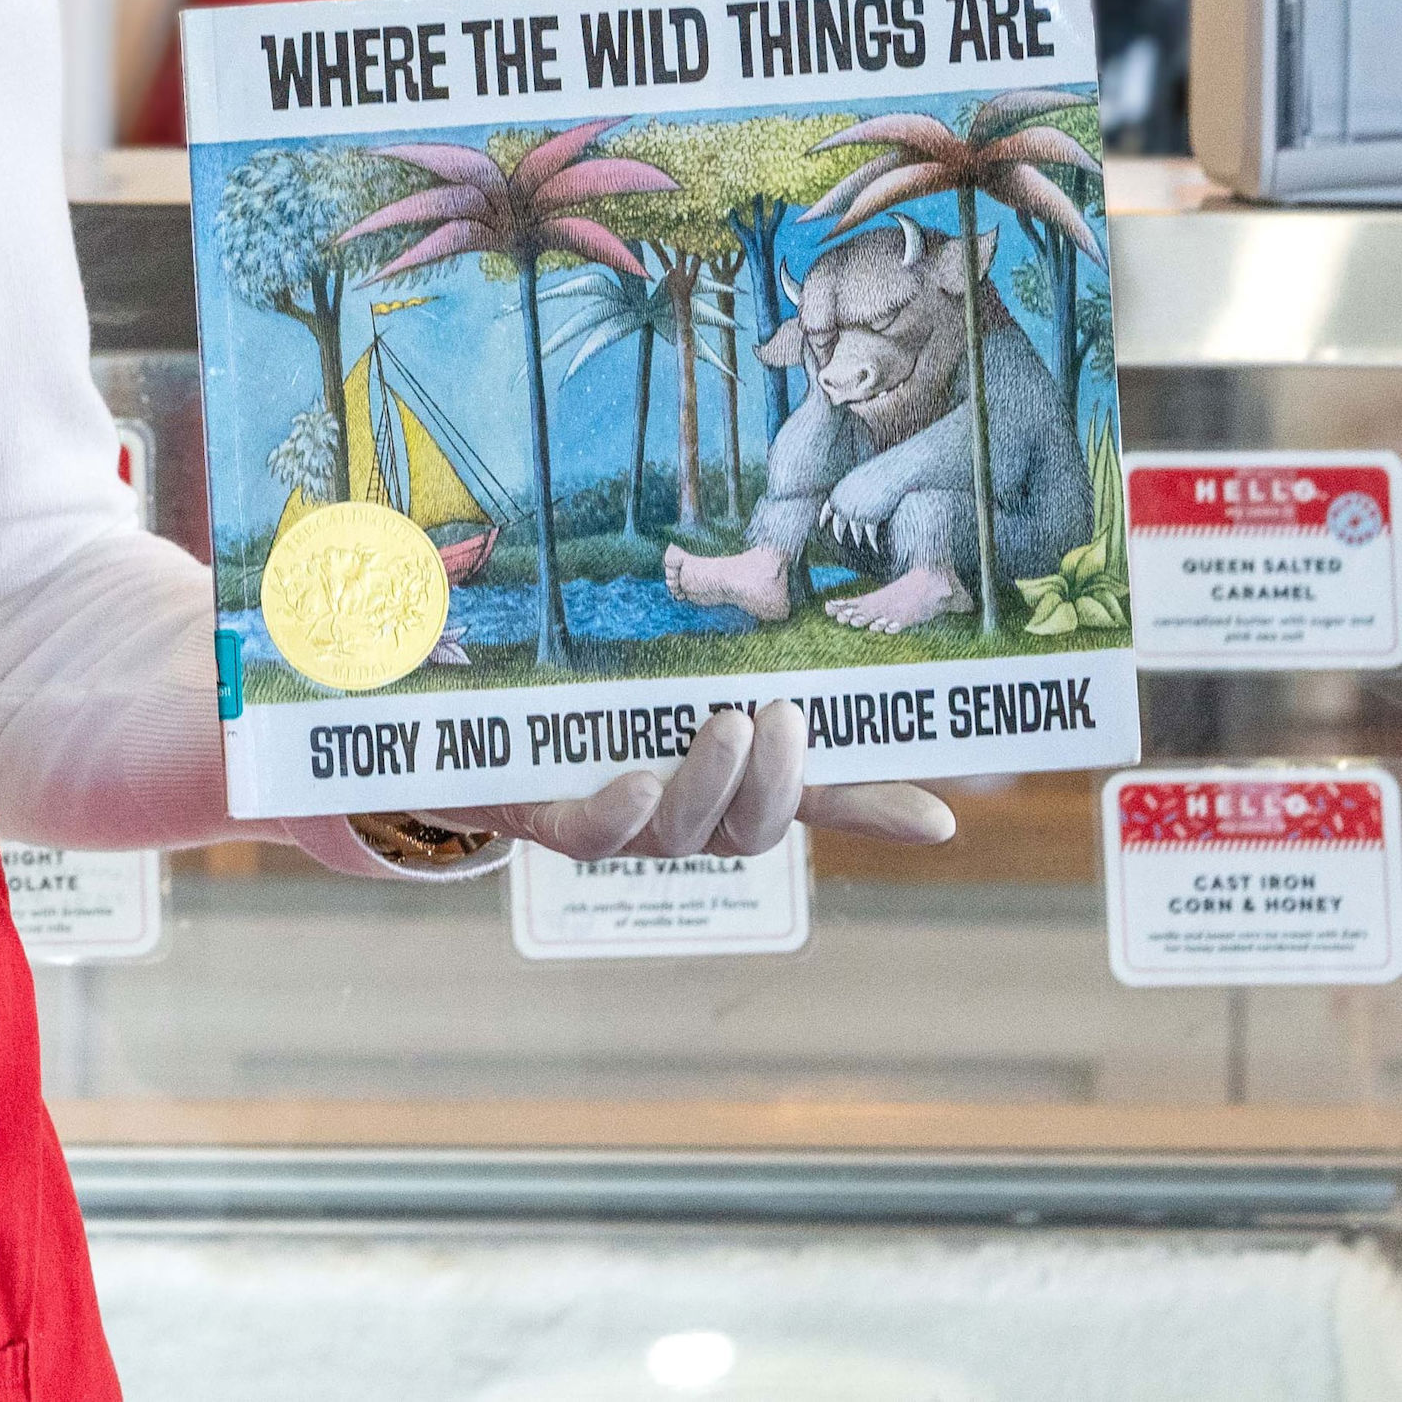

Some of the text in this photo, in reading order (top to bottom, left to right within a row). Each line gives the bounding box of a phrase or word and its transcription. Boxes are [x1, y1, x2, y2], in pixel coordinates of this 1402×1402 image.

[261, 22, 450, 112] WHERE
[462, 15, 562, 97] THE
[582, 6, 709, 88] WILD
[1196, 477, 1317, 504] HELLO
[1182, 556, 1343, 575] QUEEN SALTED
[1211, 583, 1316, 602] CARAMEL
[309, 677, 1096, 781] STORY AND PICTURES AURICE SENDAK
[1187, 793, 1310, 819] HELLO
[576, 858, 746, 876] TRIPLE VANILLA
[8, 875, 78, 892] OLATE
[1194, 874, 1316, 891] CAST IRON
[1168, 897, 1343, 914] CORN & HONEY
